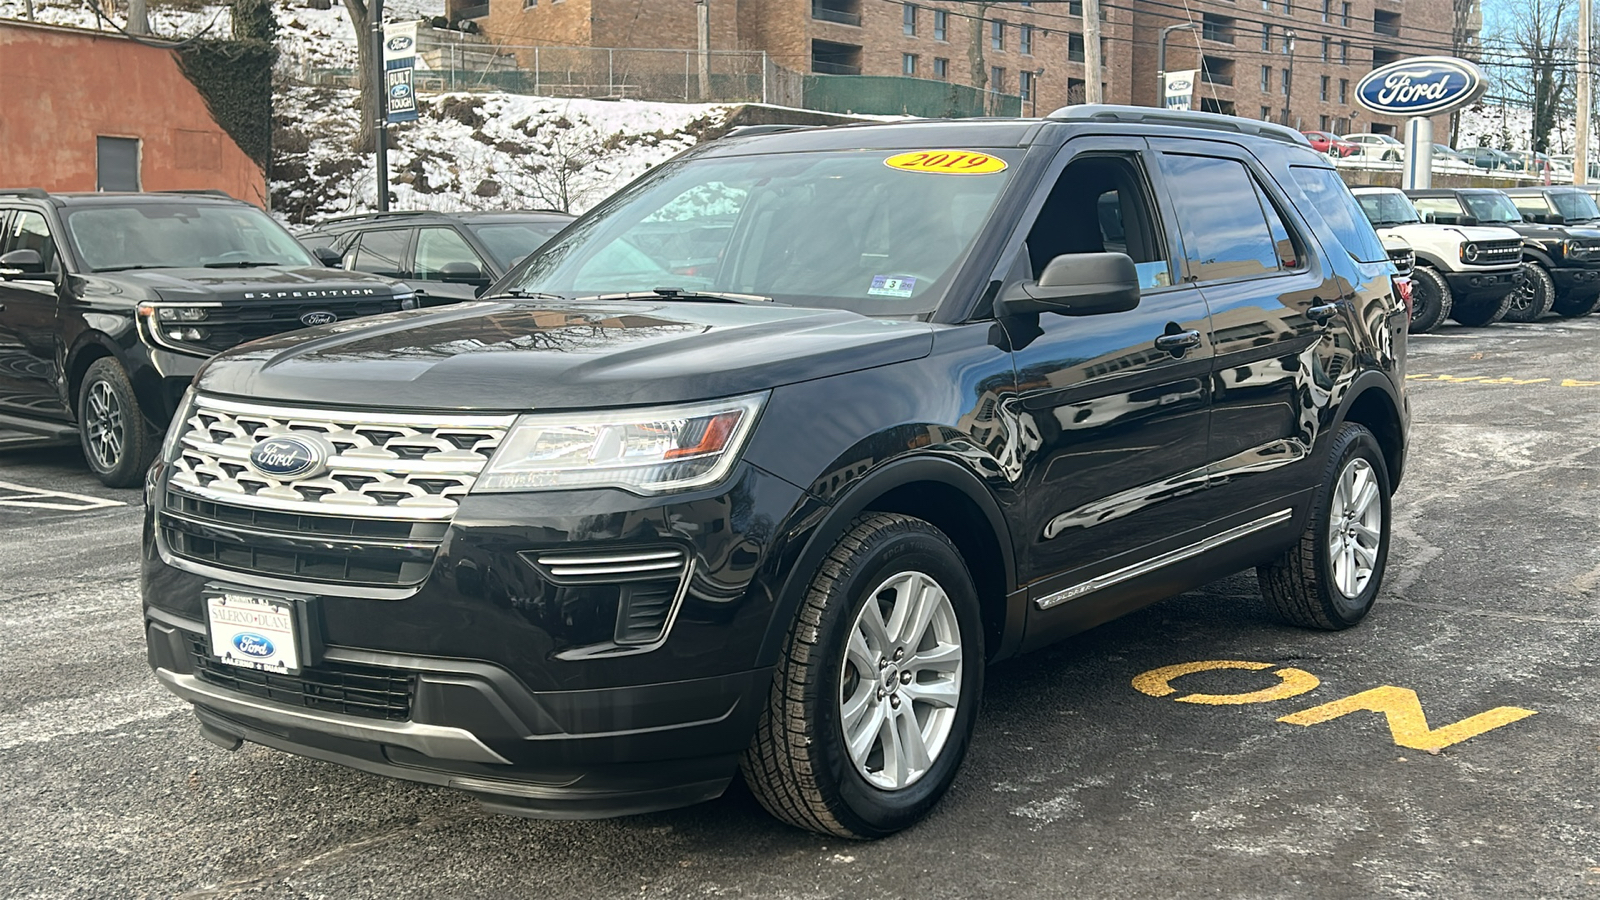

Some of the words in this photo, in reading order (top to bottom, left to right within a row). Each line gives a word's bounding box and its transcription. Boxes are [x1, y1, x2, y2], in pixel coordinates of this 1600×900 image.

[391, 37, 409, 51] Ford
[389, 71, 410, 86] BUILT
[1378, 69, 1450, 105] Ford
[390, 97, 412, 111] TOUGH
[900, 154, 989, 169] 2019
[889, 280, 897, 288] 3
[244, 289, 374, 299] EXPEDITION
[308, 314, 330, 325] Ford
[257, 442, 298, 467] Ford
[212, 607, 254, 624] SALERNO
[258, 614, 291, 630] DUANE
[239, 635, 268, 656] Ford
[221, 656, 254, 669] SALERNO
